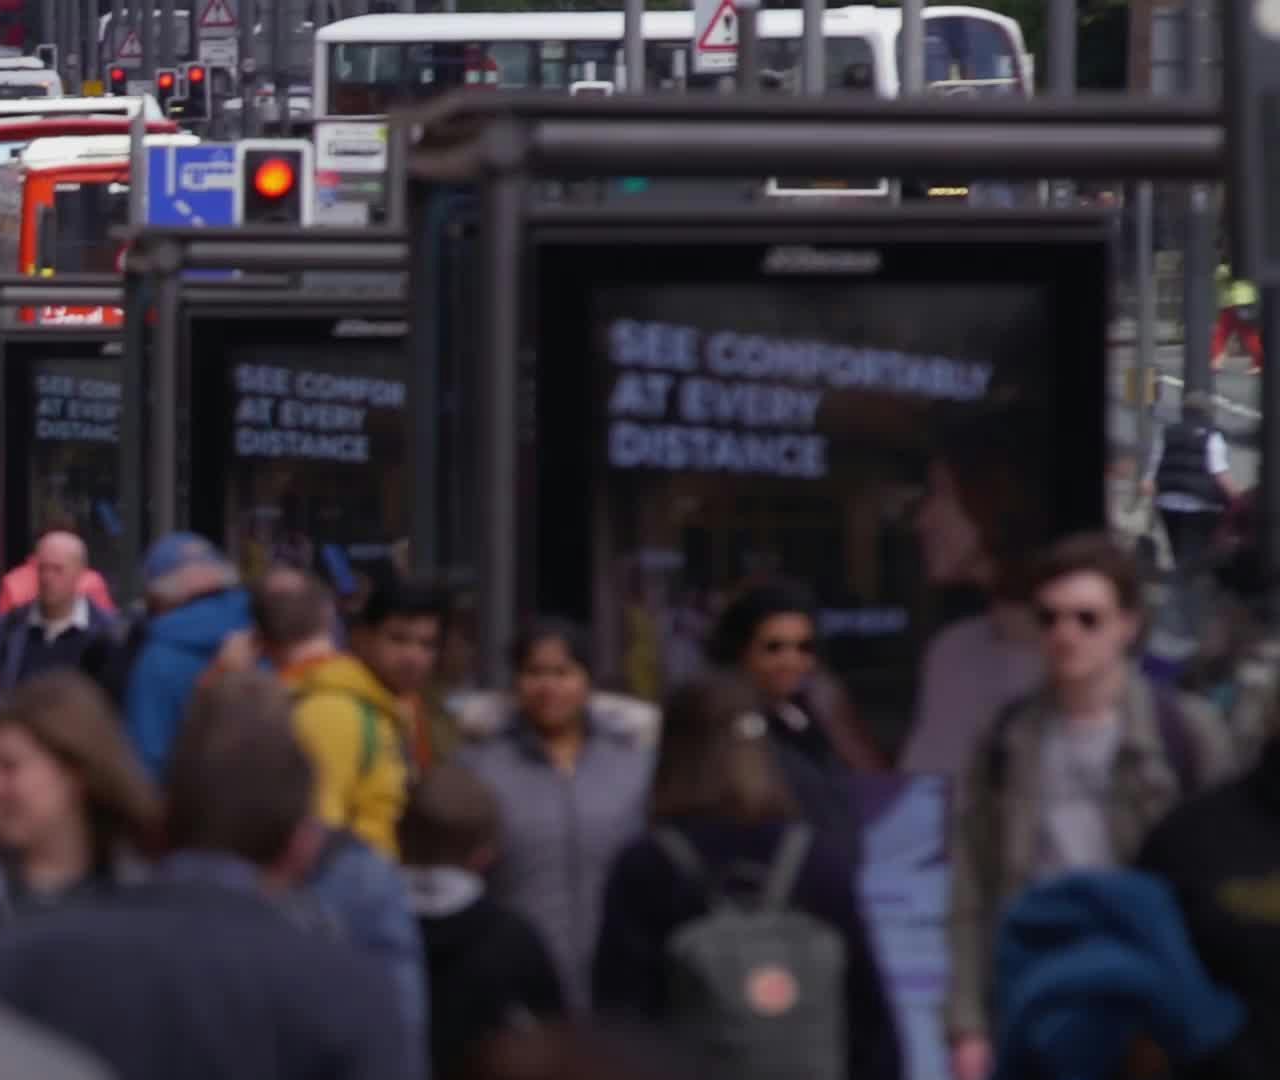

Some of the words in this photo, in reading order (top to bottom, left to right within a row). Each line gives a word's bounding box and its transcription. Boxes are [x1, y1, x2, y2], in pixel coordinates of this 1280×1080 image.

[236, 364, 289, 394] SEE
[610, 318, 697, 371] SEE
[707, 329, 994, 401] COMFORTABLY
[237, 396, 275, 422] AT
[279, 400, 367, 432] EVERY
[611, 371, 673, 418] AT
[680, 376, 822, 427] EVERY
[236, 427, 369, 462] DISTANCE
[609, 419, 831, 479] DISTANCE
